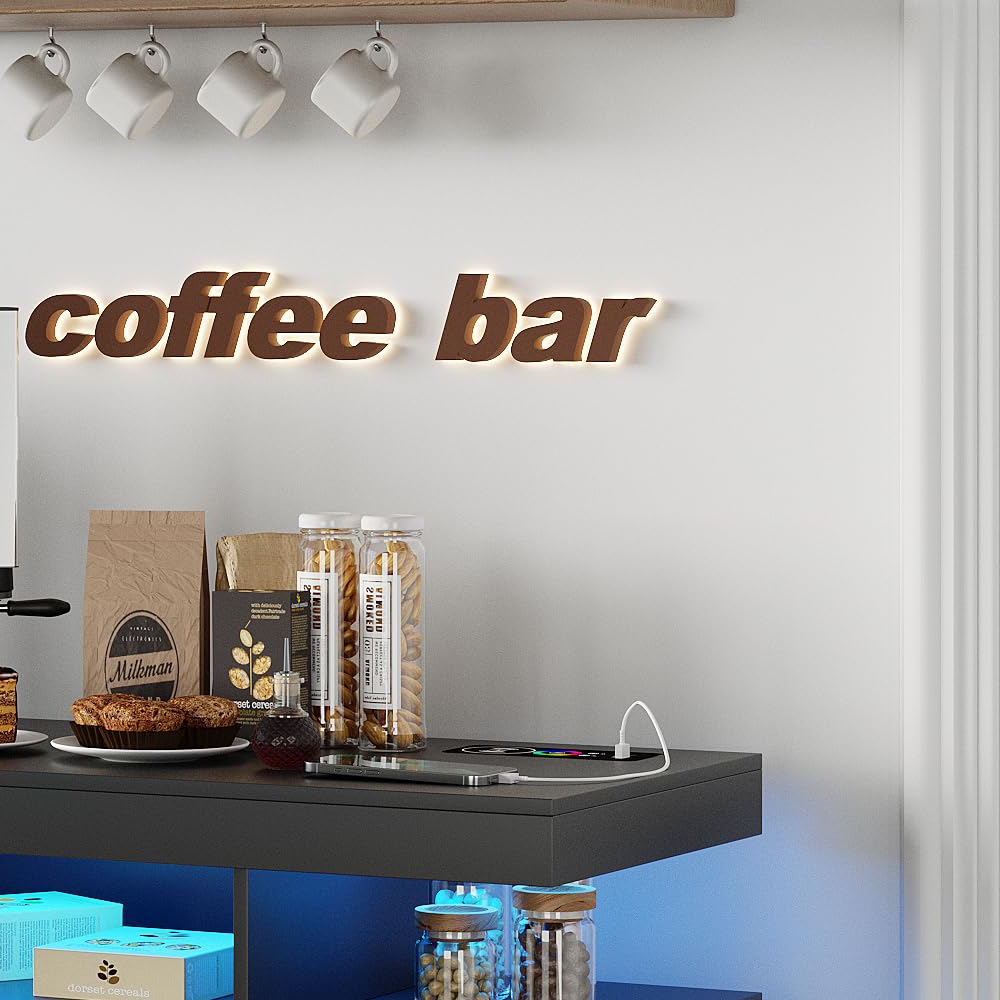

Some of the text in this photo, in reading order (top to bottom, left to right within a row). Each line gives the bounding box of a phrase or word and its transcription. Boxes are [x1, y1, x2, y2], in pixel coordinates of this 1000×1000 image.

[25, 271, 658, 364] coffee bar
[108, 658, 174, 683] Milkman
[67, 983, 150, 998] dorset cereals
